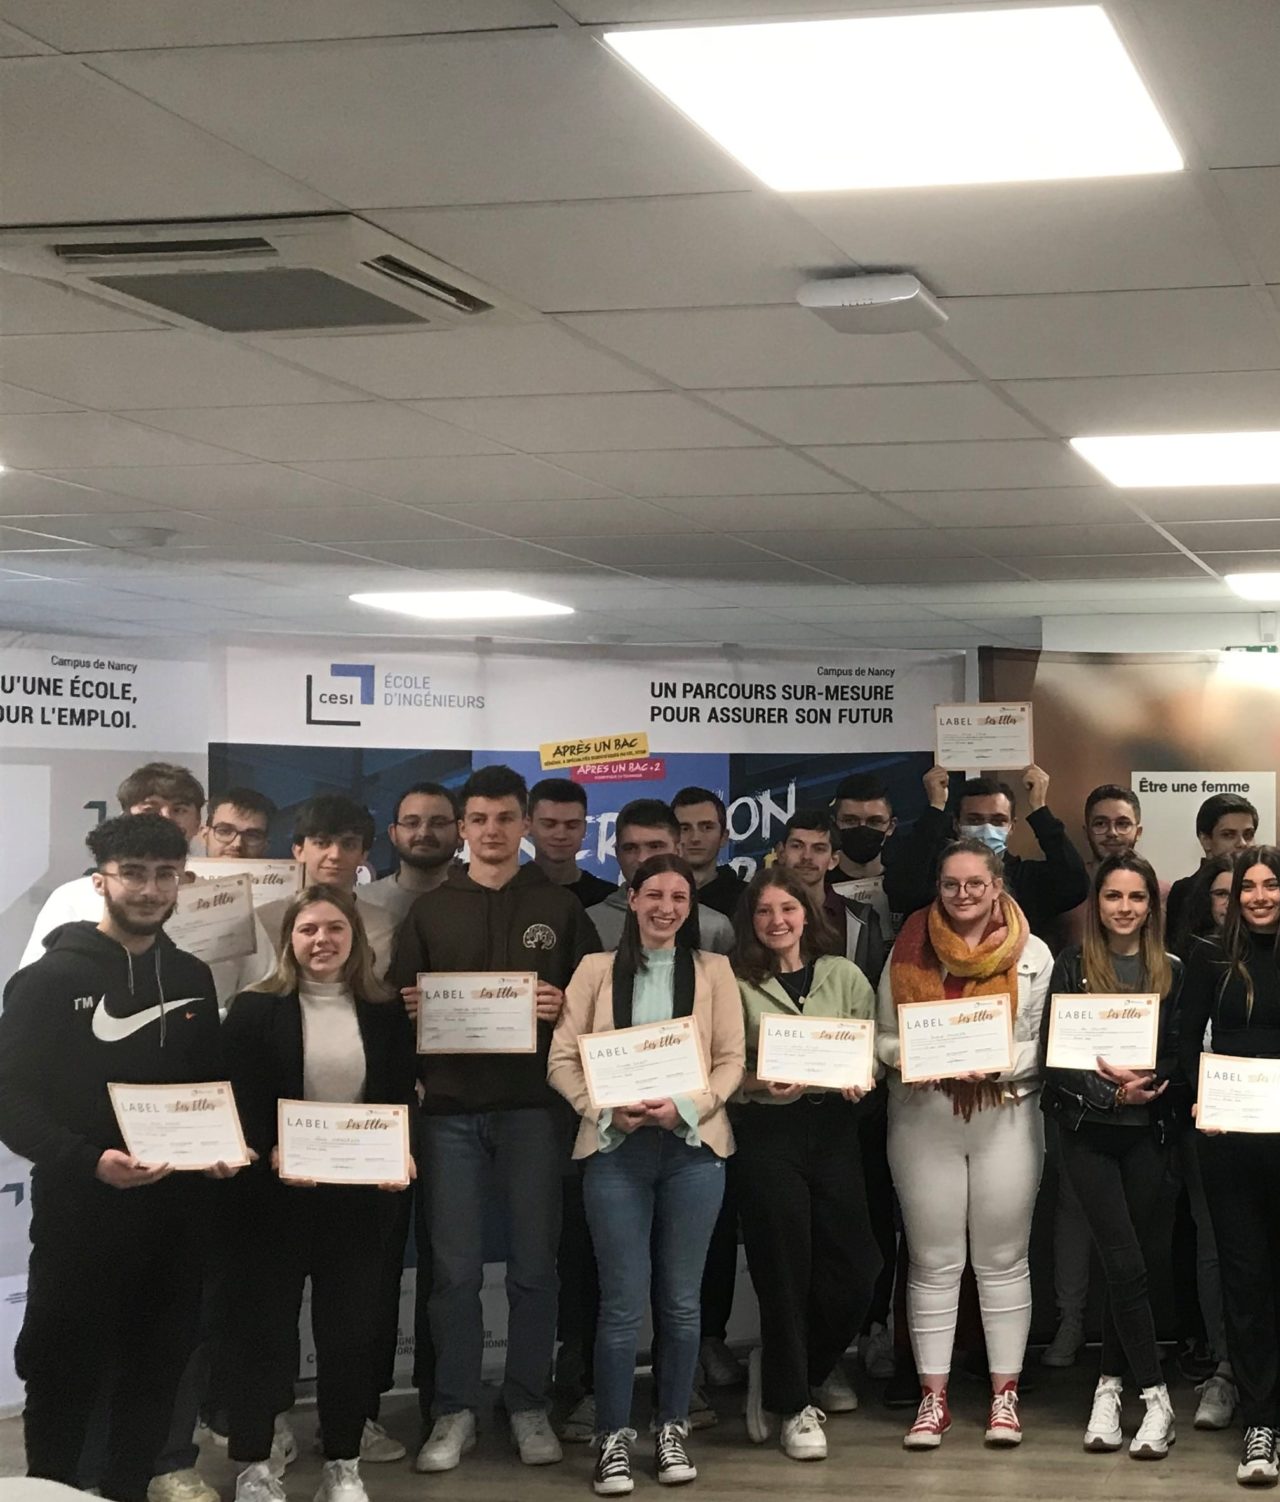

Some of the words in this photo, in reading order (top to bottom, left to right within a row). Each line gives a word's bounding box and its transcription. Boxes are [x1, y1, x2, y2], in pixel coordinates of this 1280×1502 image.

[51, 655, 91, 669] Campus
[93, 659, 105, 669] de
[107, 660, 138, 674] Nancy
[816, 666, 852, 677] Campus
[855, 667, 866, 676] de
[868, 667, 896, 678] Nancy
[384, 672, 431, 690] ÉCOLE
[0, 675, 64, 696] U'UNE
[70, 675, 138, 704] ÉCOLE,
[650, 682, 677, 699] UN
[682, 683, 776, 700] PARCOURS
[781, 684, 894, 701] SUR-MESURE
[319, 693, 353, 705] cesi
[384, 693, 486, 709] D'INGÉNIEURS
[0, 705, 34, 724] UR
[41, 706, 137, 728] L'EMPLOI.
[650, 706, 700, 723] POUR
[707, 707, 788, 724] ASSURER
[795, 708, 831, 724] SON
[838, 708, 893, 724] FUTUR
[552, 740, 591, 758] APRÈS
[594, 739, 611, 752] UN
[614, 738, 638, 750] BAC
[611, 763, 626, 774] UN
[1139, 778, 1168, 792] Être
[1171, 783, 1198, 793] une
[1202, 781, 1250, 793] femme
[426, 990, 464, 999] LABEL
[480, 987, 494, 999] Les
[496, 985, 518, 998] Elles
[907, 1018, 943, 1029] LABEL
[958, 1013, 970, 1024] Les
[974, 1009, 993, 1022] Elles
[1058, 1010, 1093, 1019] LABEL
[1107, 1008, 1118, 1019] Les
[1122, 1007, 1141, 1019] Elles
[768, 1028, 805, 1038] LABEL
[820, 1030, 832, 1040] Les
[835, 1030, 856, 1041] Elles
[589, 1046, 628, 1060] LABEL
[643, 1040, 656, 1050] Les
[660, 1034, 681, 1047] Elles
[1207, 1071, 1242, 1082] LABEL
[121, 1102, 159, 1112] LABEL
[175, 1101, 189, 1111] Les
[192, 1099, 216, 1111] Elles
[287, 1118, 328, 1129] LABEL
[346, 1119, 361, 1130] Les
[364, 1119, 388, 1130] Elles
